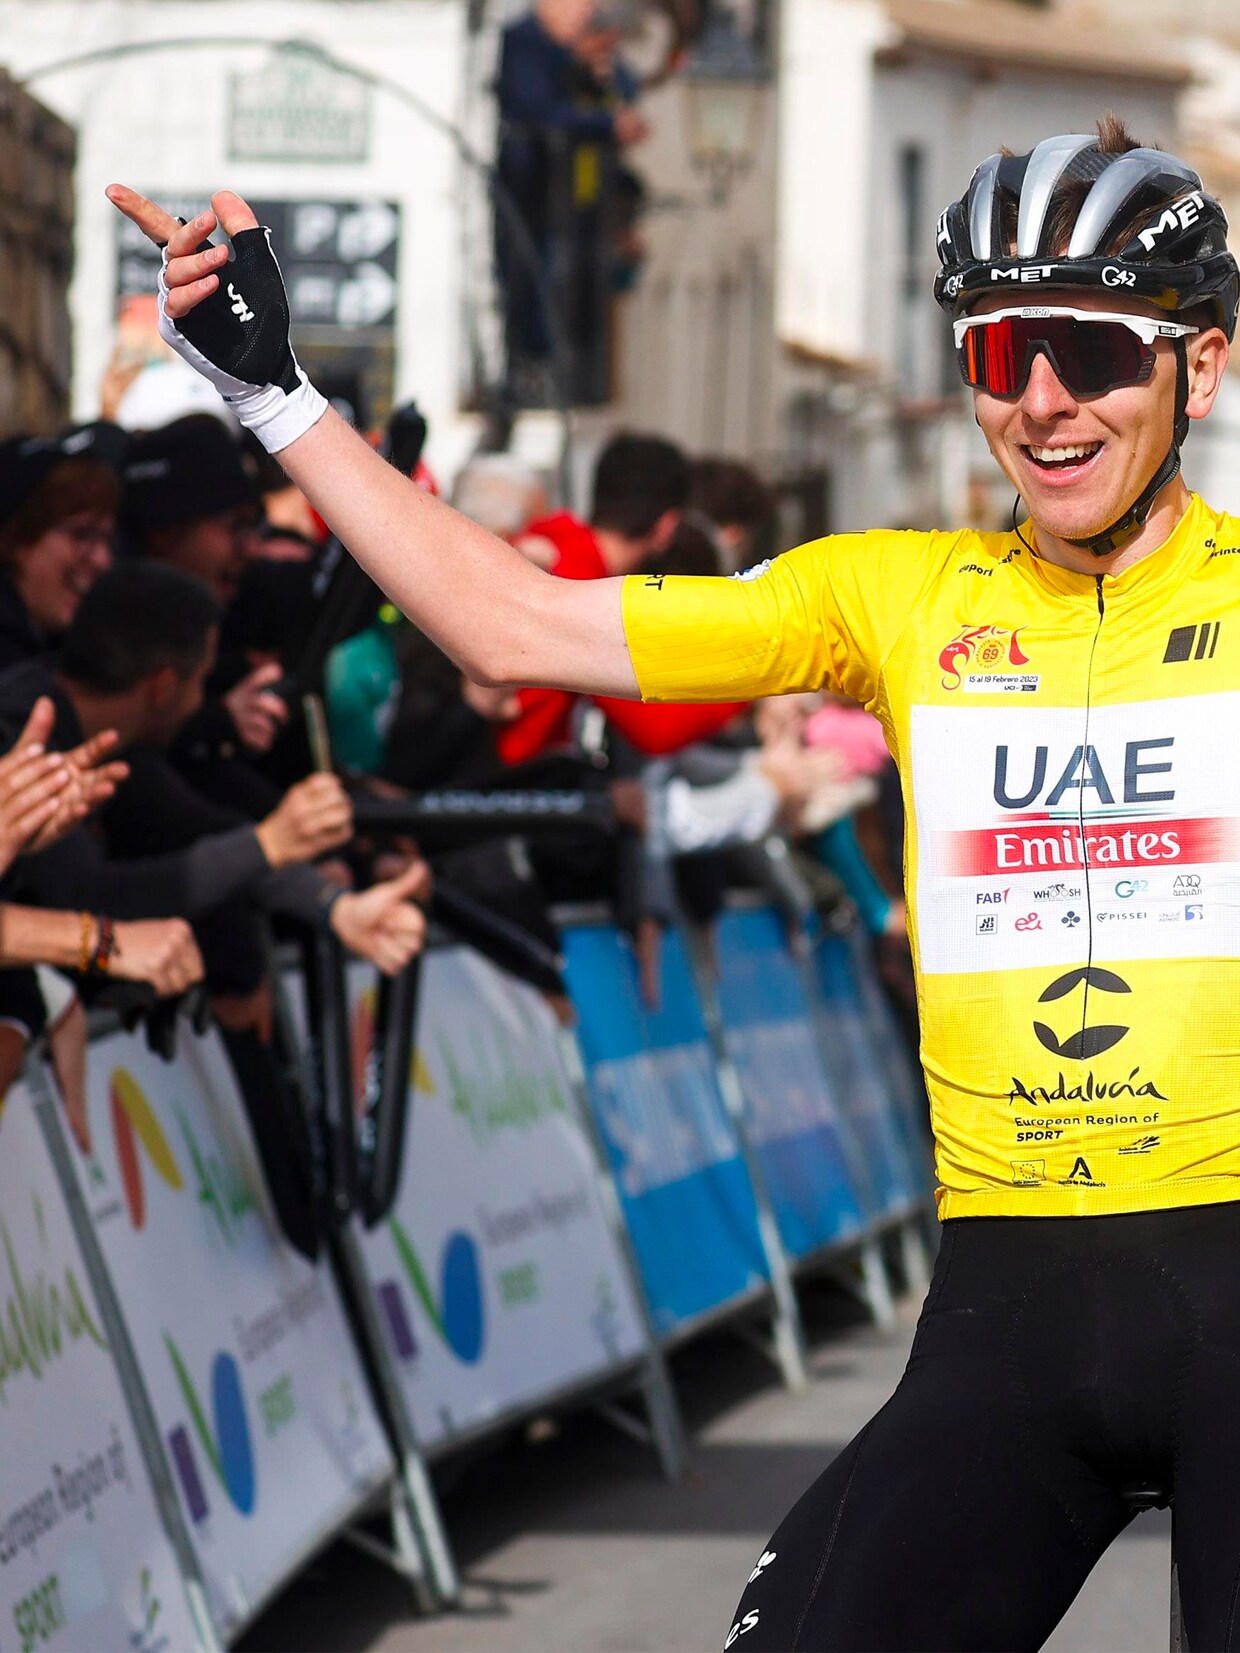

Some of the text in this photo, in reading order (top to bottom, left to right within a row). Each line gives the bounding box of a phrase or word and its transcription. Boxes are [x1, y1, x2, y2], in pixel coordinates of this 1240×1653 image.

[1137, 190, 1205, 252] MET
[990, 264, 1059, 283] MET
[1101, 265, 1137, 287] G42
[982, 648, 999, 660] 69
[1019, 675, 1038, 683] 2023
[993, 737, 1176, 810] UAE
[994, 829, 1181, 869] Emirates
[1109, 912, 1147, 920] PISSEI
[1003, 1066, 1170, 1106] Andalucía
[1014, 1112, 1160, 1128] European Region of
[1016, 1130, 1064, 1142] SPORT
